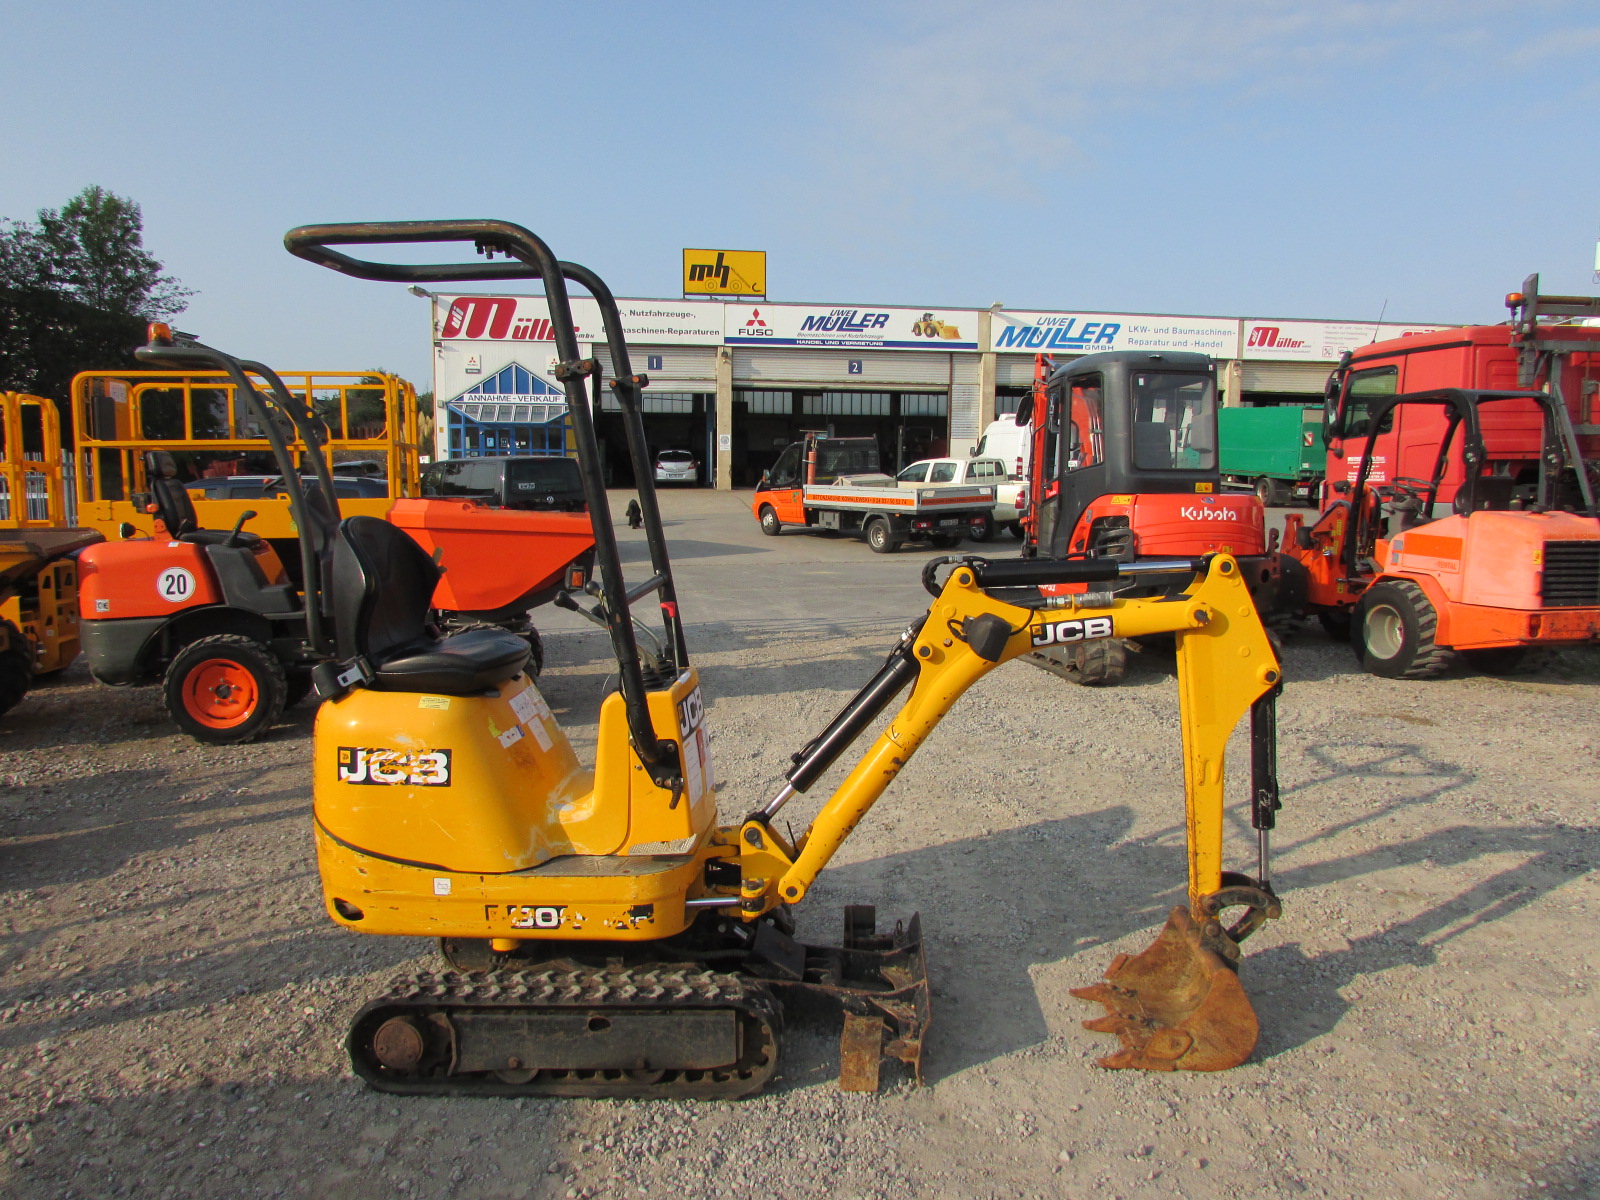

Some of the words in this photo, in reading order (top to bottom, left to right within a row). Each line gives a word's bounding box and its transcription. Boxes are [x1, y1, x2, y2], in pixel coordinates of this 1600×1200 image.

[689, 252, 730, 288] mh
[441, 297, 580, 341] Müll
[629, 309, 697, 319] Nutzfahrzeuge-,
[800, 310, 890, 333] MÜLLER
[830, 309, 852, 317] UWE
[1037, 317, 1069, 327] UWE
[738, 328, 773, 336] FUSO
[995, 318, 1121, 349] MÜLLER
[1128, 325, 1151, 333] LKW-
[1172, 327, 1236, 336] Baumaschinen-
[1247, 327, 1305, 348] Müller
[1128, 338, 1169, 347] Reparatur
[1172, 339, 1188, 347] und
[852, 362, 858, 372] 2
[468, 394, 511, 402] ANNAHME
[518, 395, 561, 403] VERKAUF
[1181, 506, 1237, 521] Kubota
[165, 574, 187, 595] 20
[1033, 618, 1112, 646] JCB
[680, 686, 704, 737] JCB
[339, 749, 449, 784] JCB
